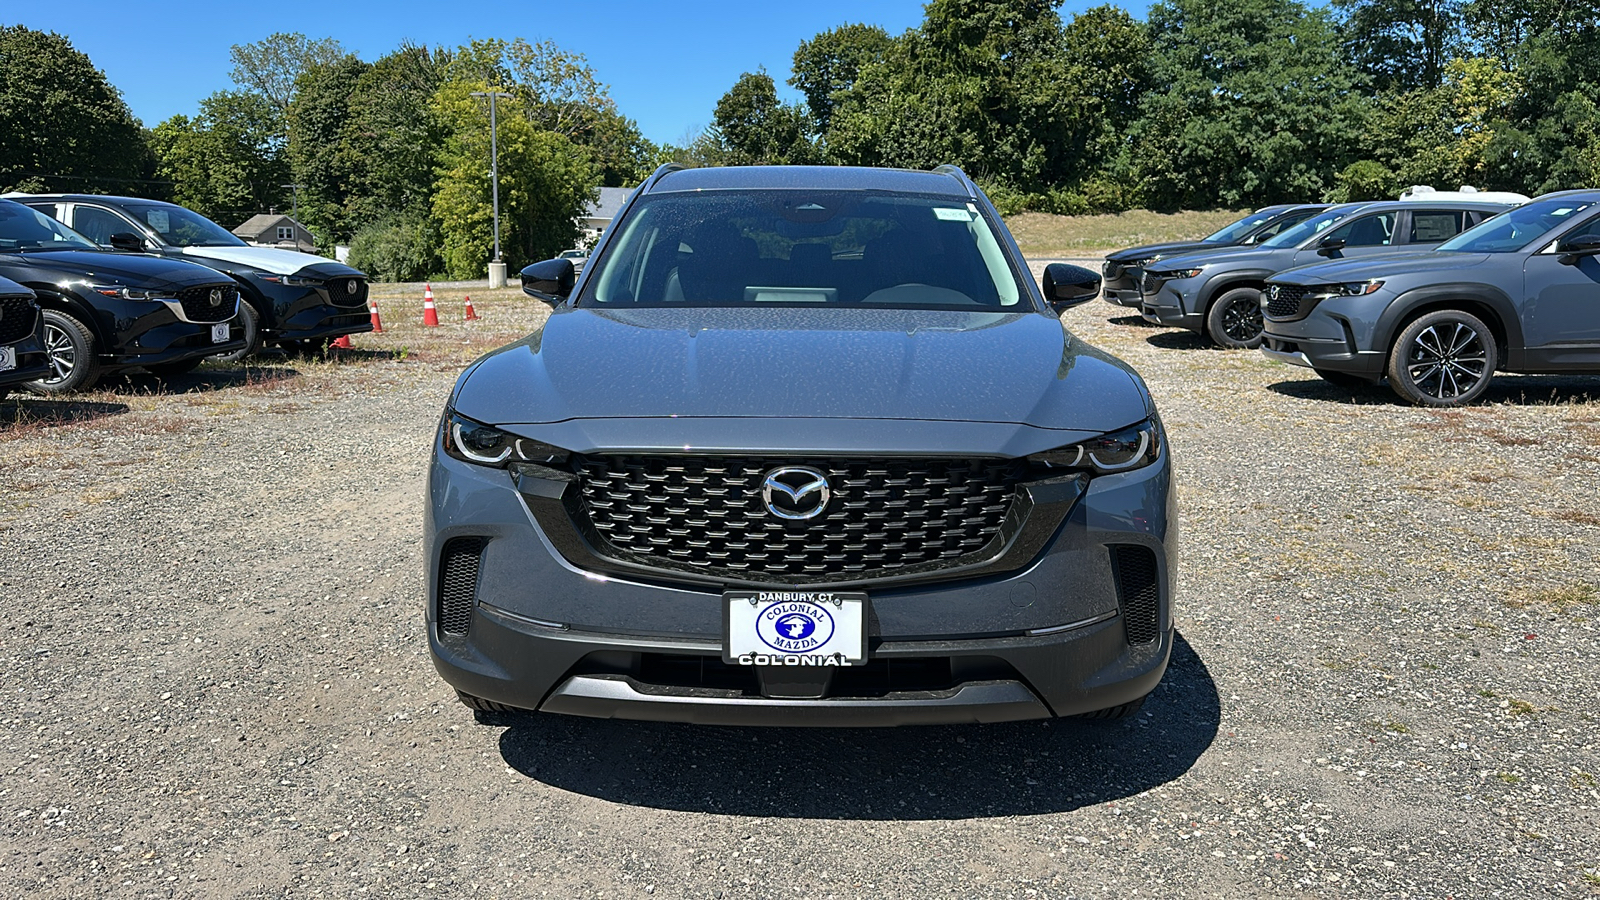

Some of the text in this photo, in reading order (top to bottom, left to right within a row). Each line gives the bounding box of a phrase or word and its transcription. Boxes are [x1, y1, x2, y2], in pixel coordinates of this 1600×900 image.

[759, 592, 834, 602] DANBURY, CT
[766, 604, 825, 623] COLONIAL
[774, 636, 819, 650] MAZDA
[738, 655, 852, 667] COLONIAL
